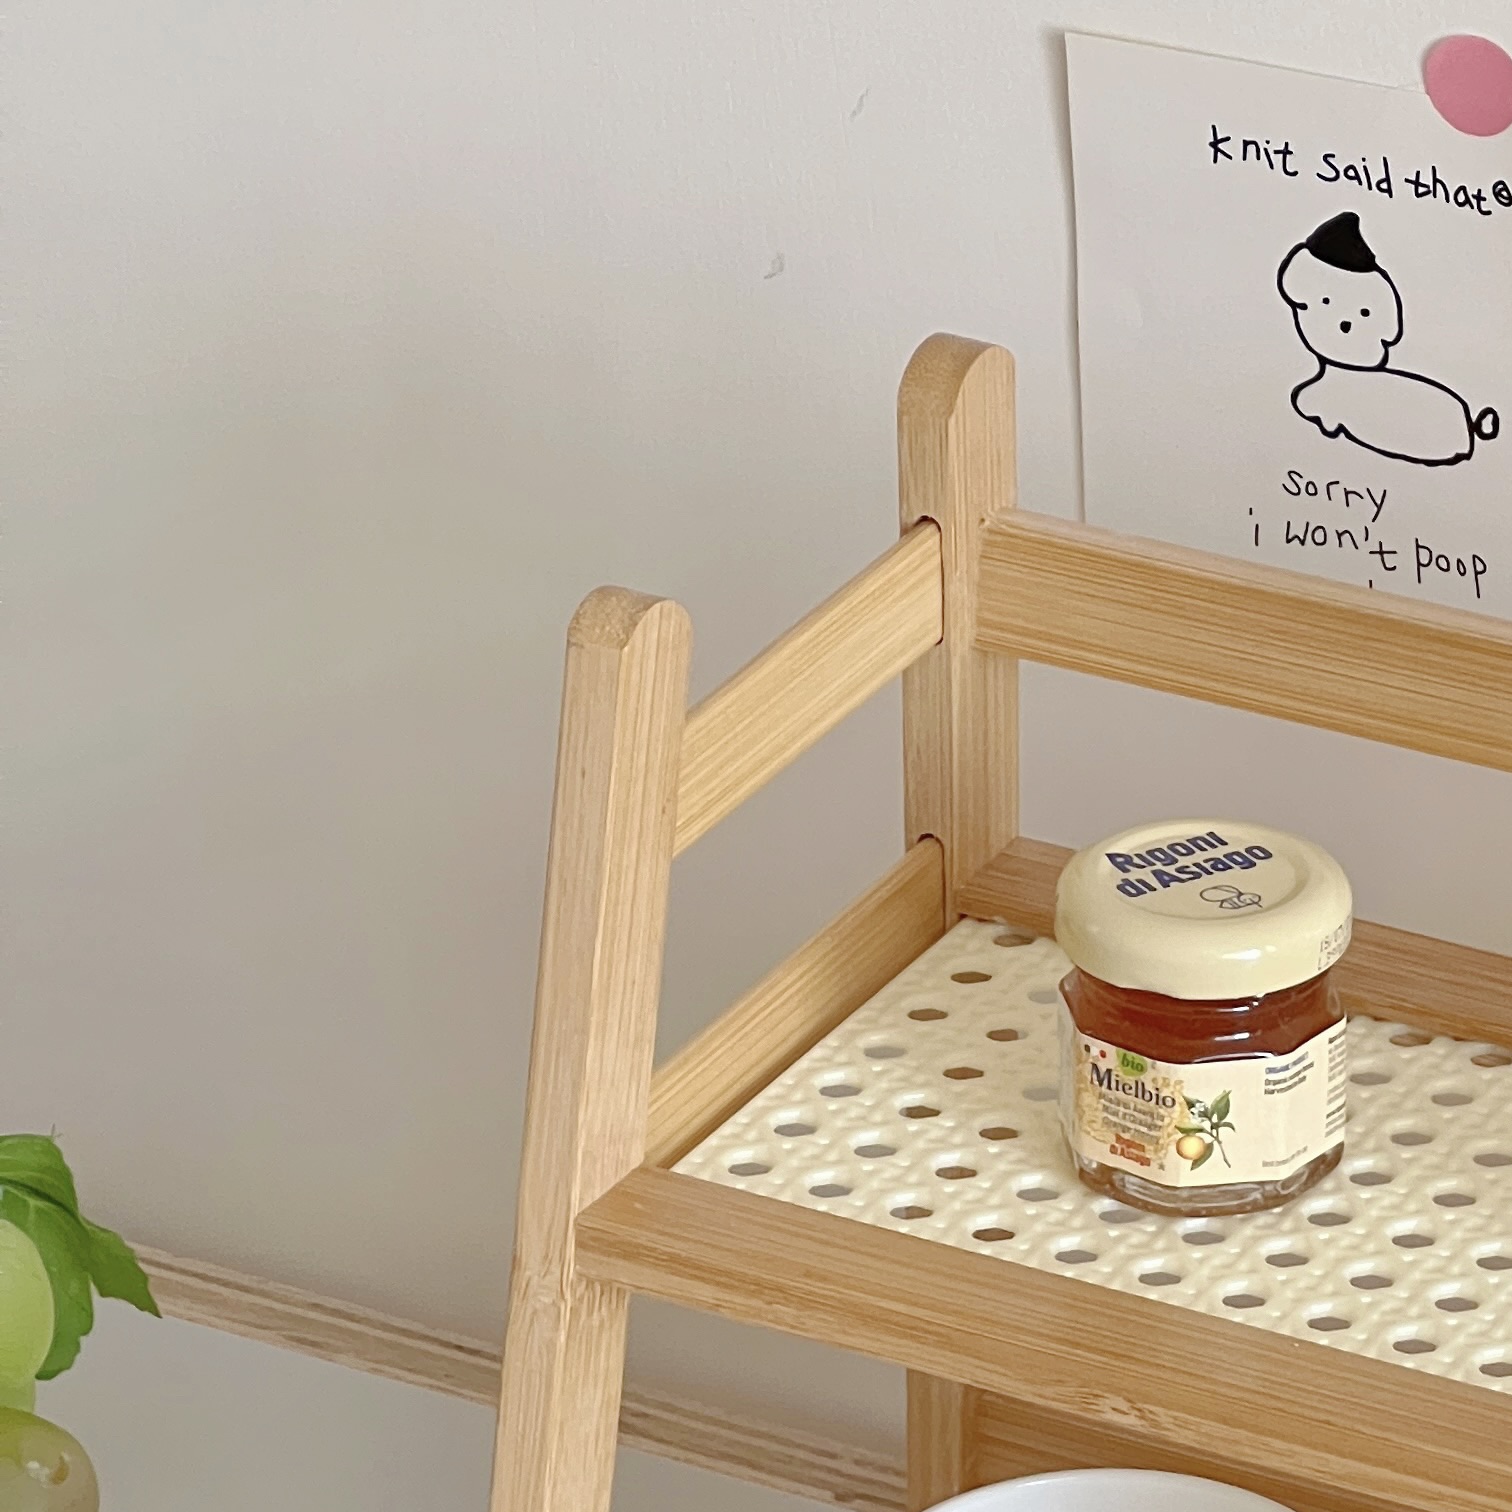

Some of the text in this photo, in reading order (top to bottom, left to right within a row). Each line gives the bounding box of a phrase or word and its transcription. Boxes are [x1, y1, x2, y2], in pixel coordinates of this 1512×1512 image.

[1208, 125, 1298, 177] knit
[1285, 521, 1397, 573] won't
[1415, 538, 1487, 599] poop
[1104, 830, 1229, 875] Rigoni
[1155, 845, 1273, 890] Asiago
[1090, 1062, 1177, 1109] Mielbio
[1121, 1053, 1144, 1072] bio
